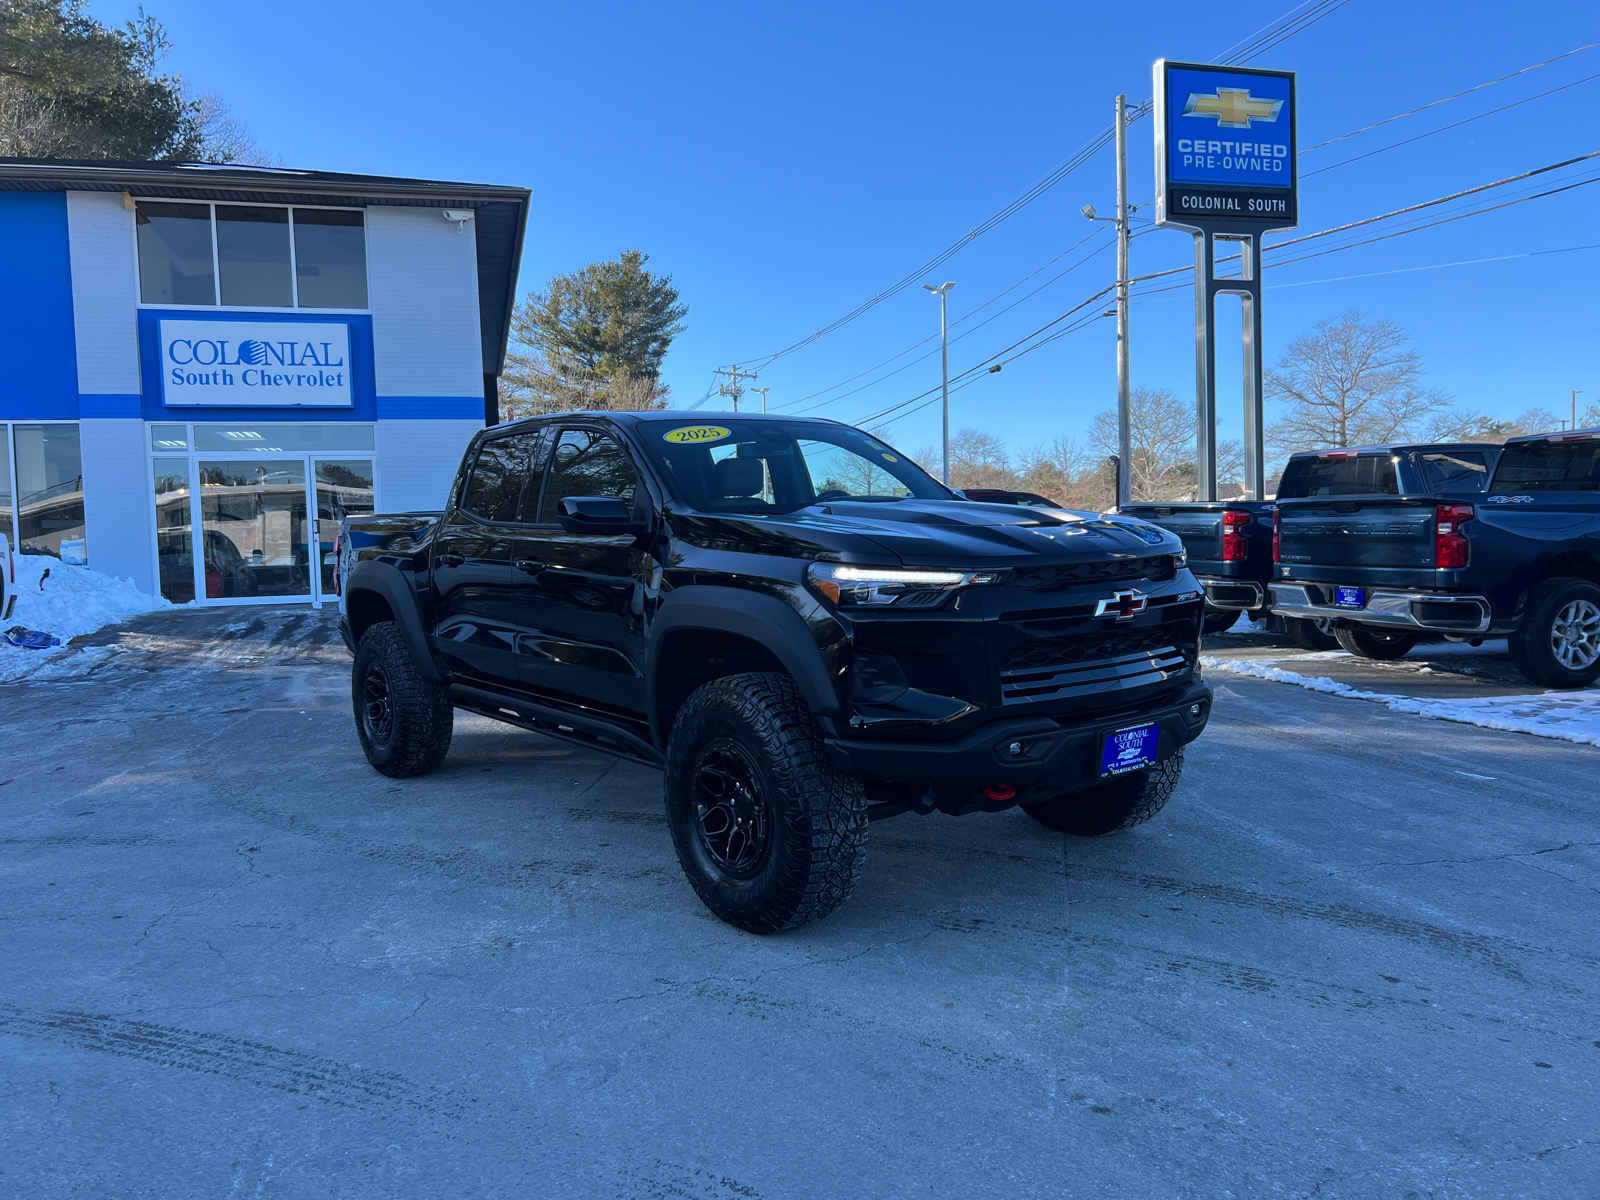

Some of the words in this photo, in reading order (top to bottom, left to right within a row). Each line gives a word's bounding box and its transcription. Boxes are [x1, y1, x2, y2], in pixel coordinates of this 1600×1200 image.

[1178, 139, 1287, 157] CERTIFIED
[1183, 155, 1283, 172] PRE-OWNED
[1181, 195, 1241, 211] COLONIAL
[1248, 198, 1286, 212] SOUTH
[168, 339, 344, 367] COLONIAL
[171, 367, 234, 386] South
[241, 368, 344, 387] Chevrolet
[676, 427, 721, 442] 2025
[1283, 523, 1420, 535] CHEVROLET
[1114, 729, 1150, 744] COLONIAL
[1118, 738, 1143, 751] SOUTH
